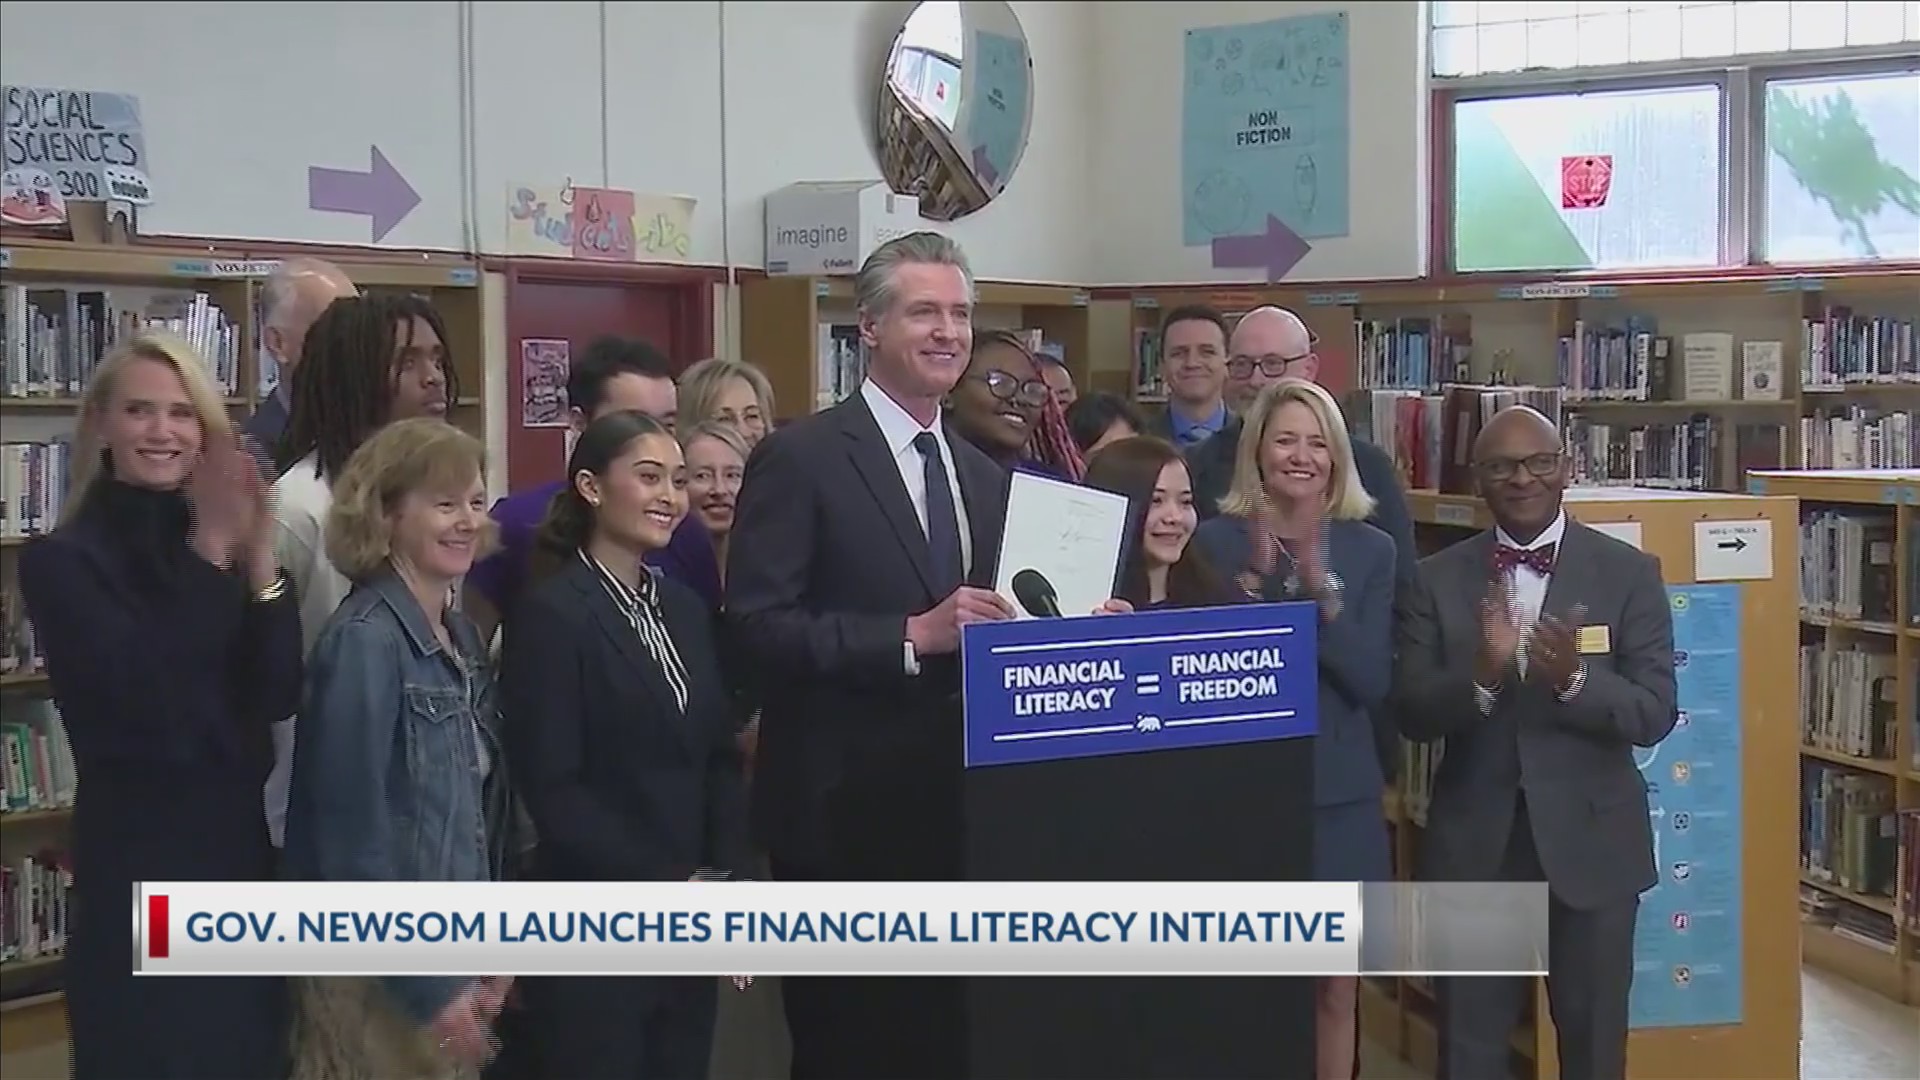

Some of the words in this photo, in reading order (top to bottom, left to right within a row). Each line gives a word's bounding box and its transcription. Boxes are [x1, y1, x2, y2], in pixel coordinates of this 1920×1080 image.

[7, 87, 105, 129] SOCIAL
[1248, 110, 1278, 127] NON
[7, 130, 138, 166] SCIENCES
[1236, 126, 1291, 146] FICTION
[56, 170, 99, 197] 300
[1568, 173, 1608, 192] STOP
[776, 224, 848, 249] imagine
[1004, 659, 1126, 689] FINANCIAL
[1171, 648, 1285, 676] FINANCIAL
[1014, 687, 1117, 716] LITERACY
[1179, 675, 1278, 703] FREEDOM
